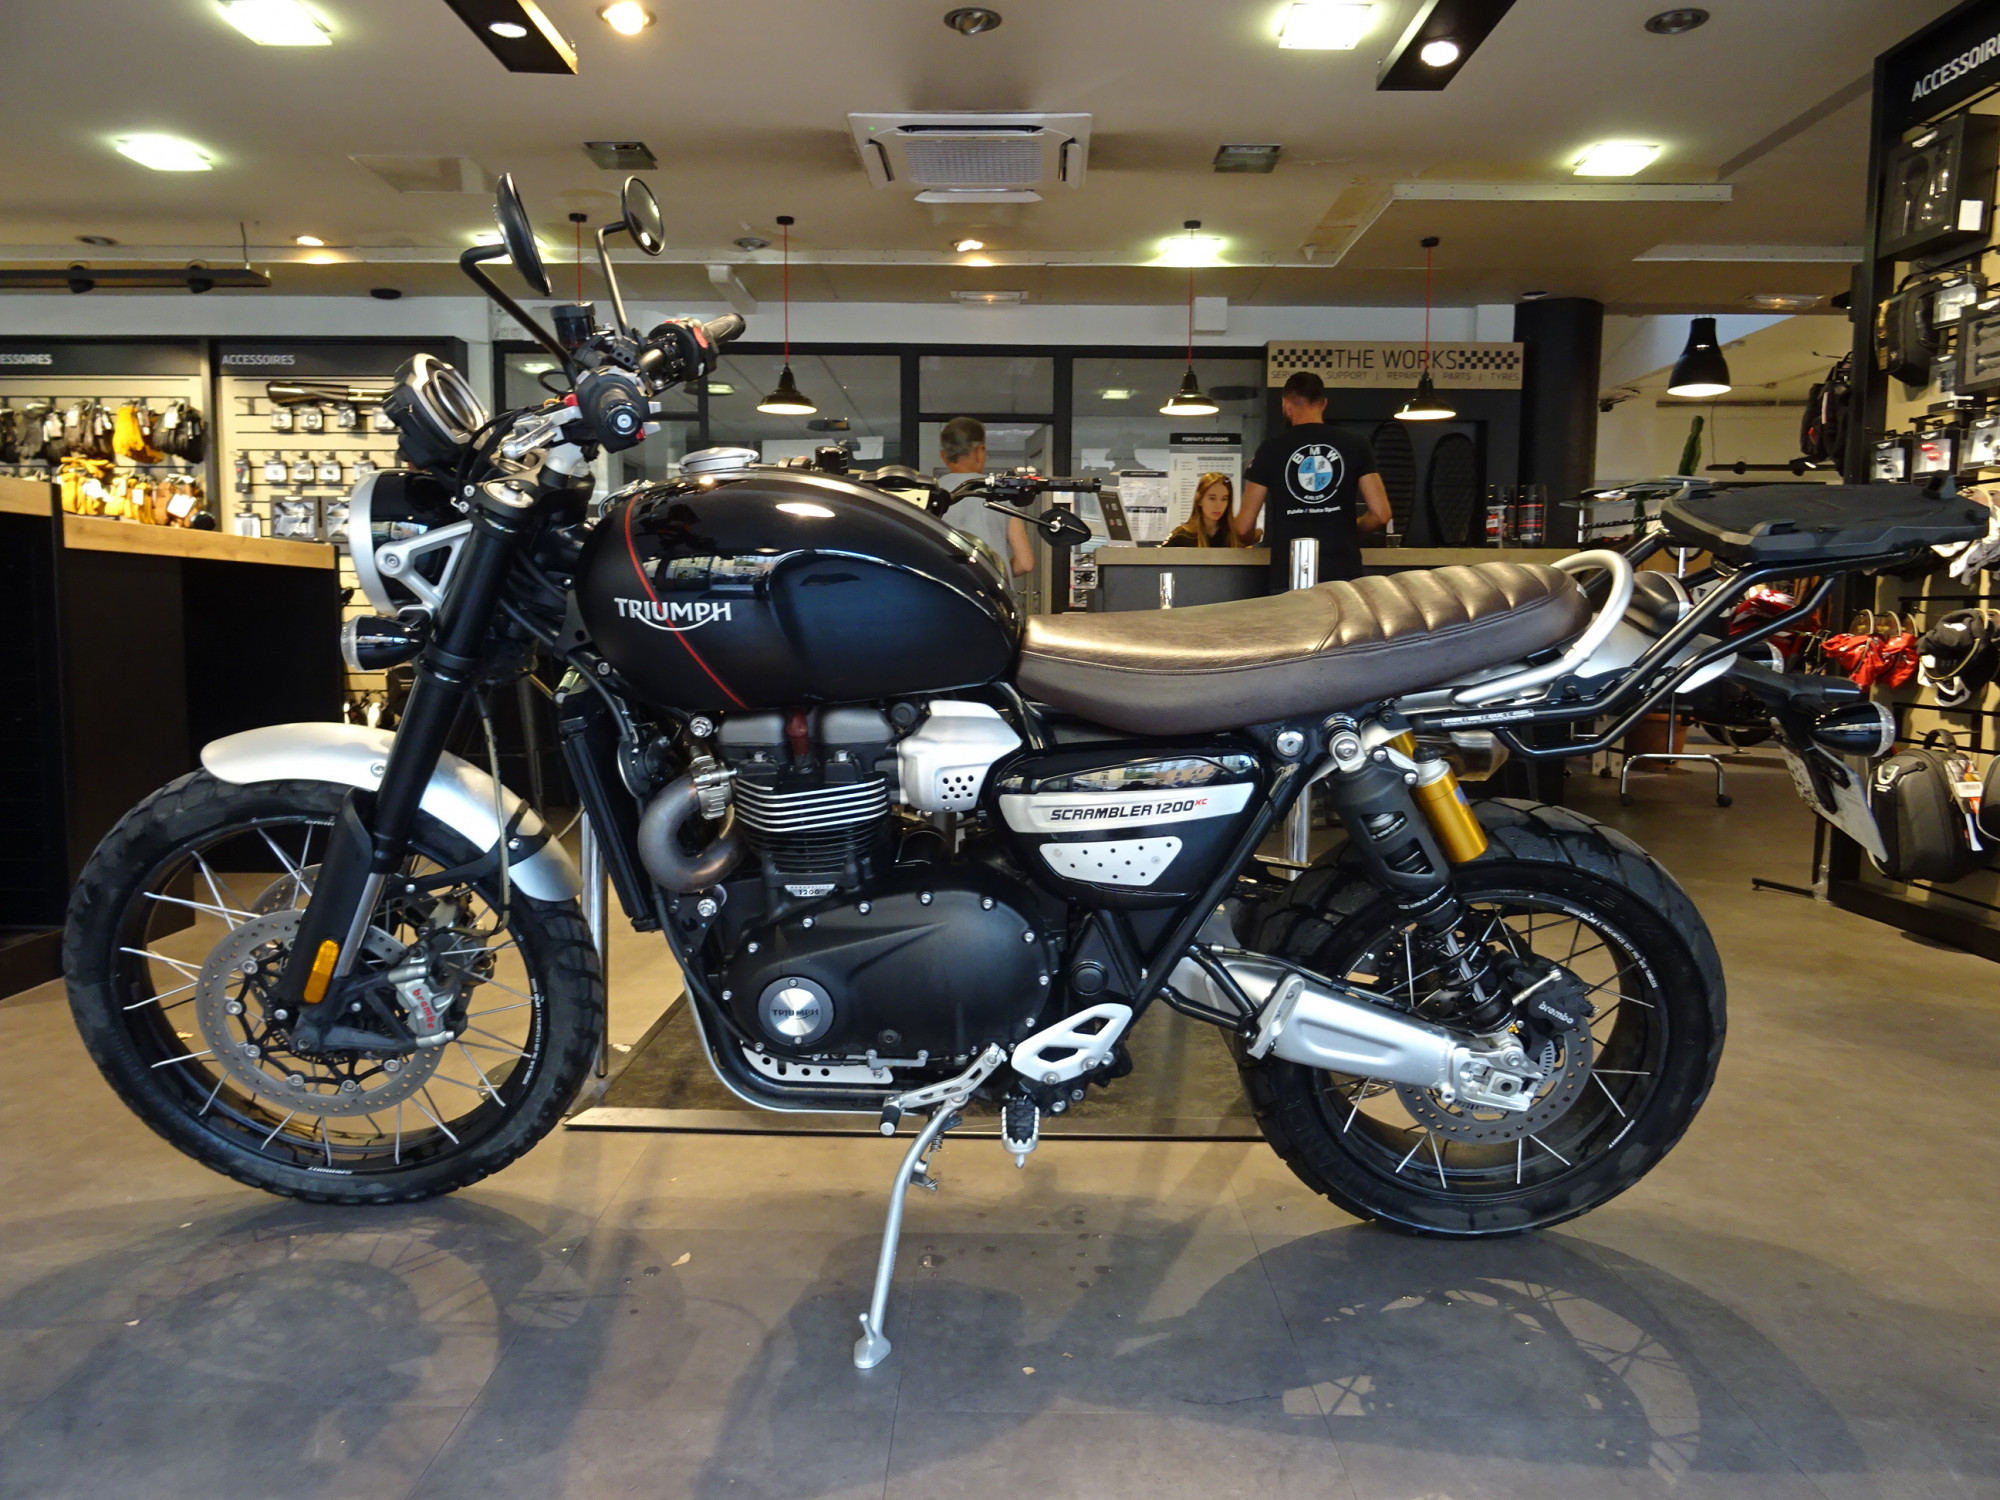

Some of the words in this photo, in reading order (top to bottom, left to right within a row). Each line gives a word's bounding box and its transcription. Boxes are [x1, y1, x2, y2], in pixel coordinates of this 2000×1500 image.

[222, 354, 296, 365] ACCESSOIRES
[1334, 349, 1375, 369] THE
[1382, 349, 1457, 370] WORKS
[1326, 370, 1368, 380] SUPPORT
[1442, 371, 1472, 381] PARTS
[1490, 372, 1520, 381] TYRES
[1291, 446, 1340, 465] BMW
[613, 597, 732, 628] TRIUMPH
[1050, 804, 1153, 821] SCRAMBLER
[412, 987, 437, 1030] brembo
[771, 1008, 819, 1018] TRIUMPH
[1537, 1000, 1575, 1025] brembo
